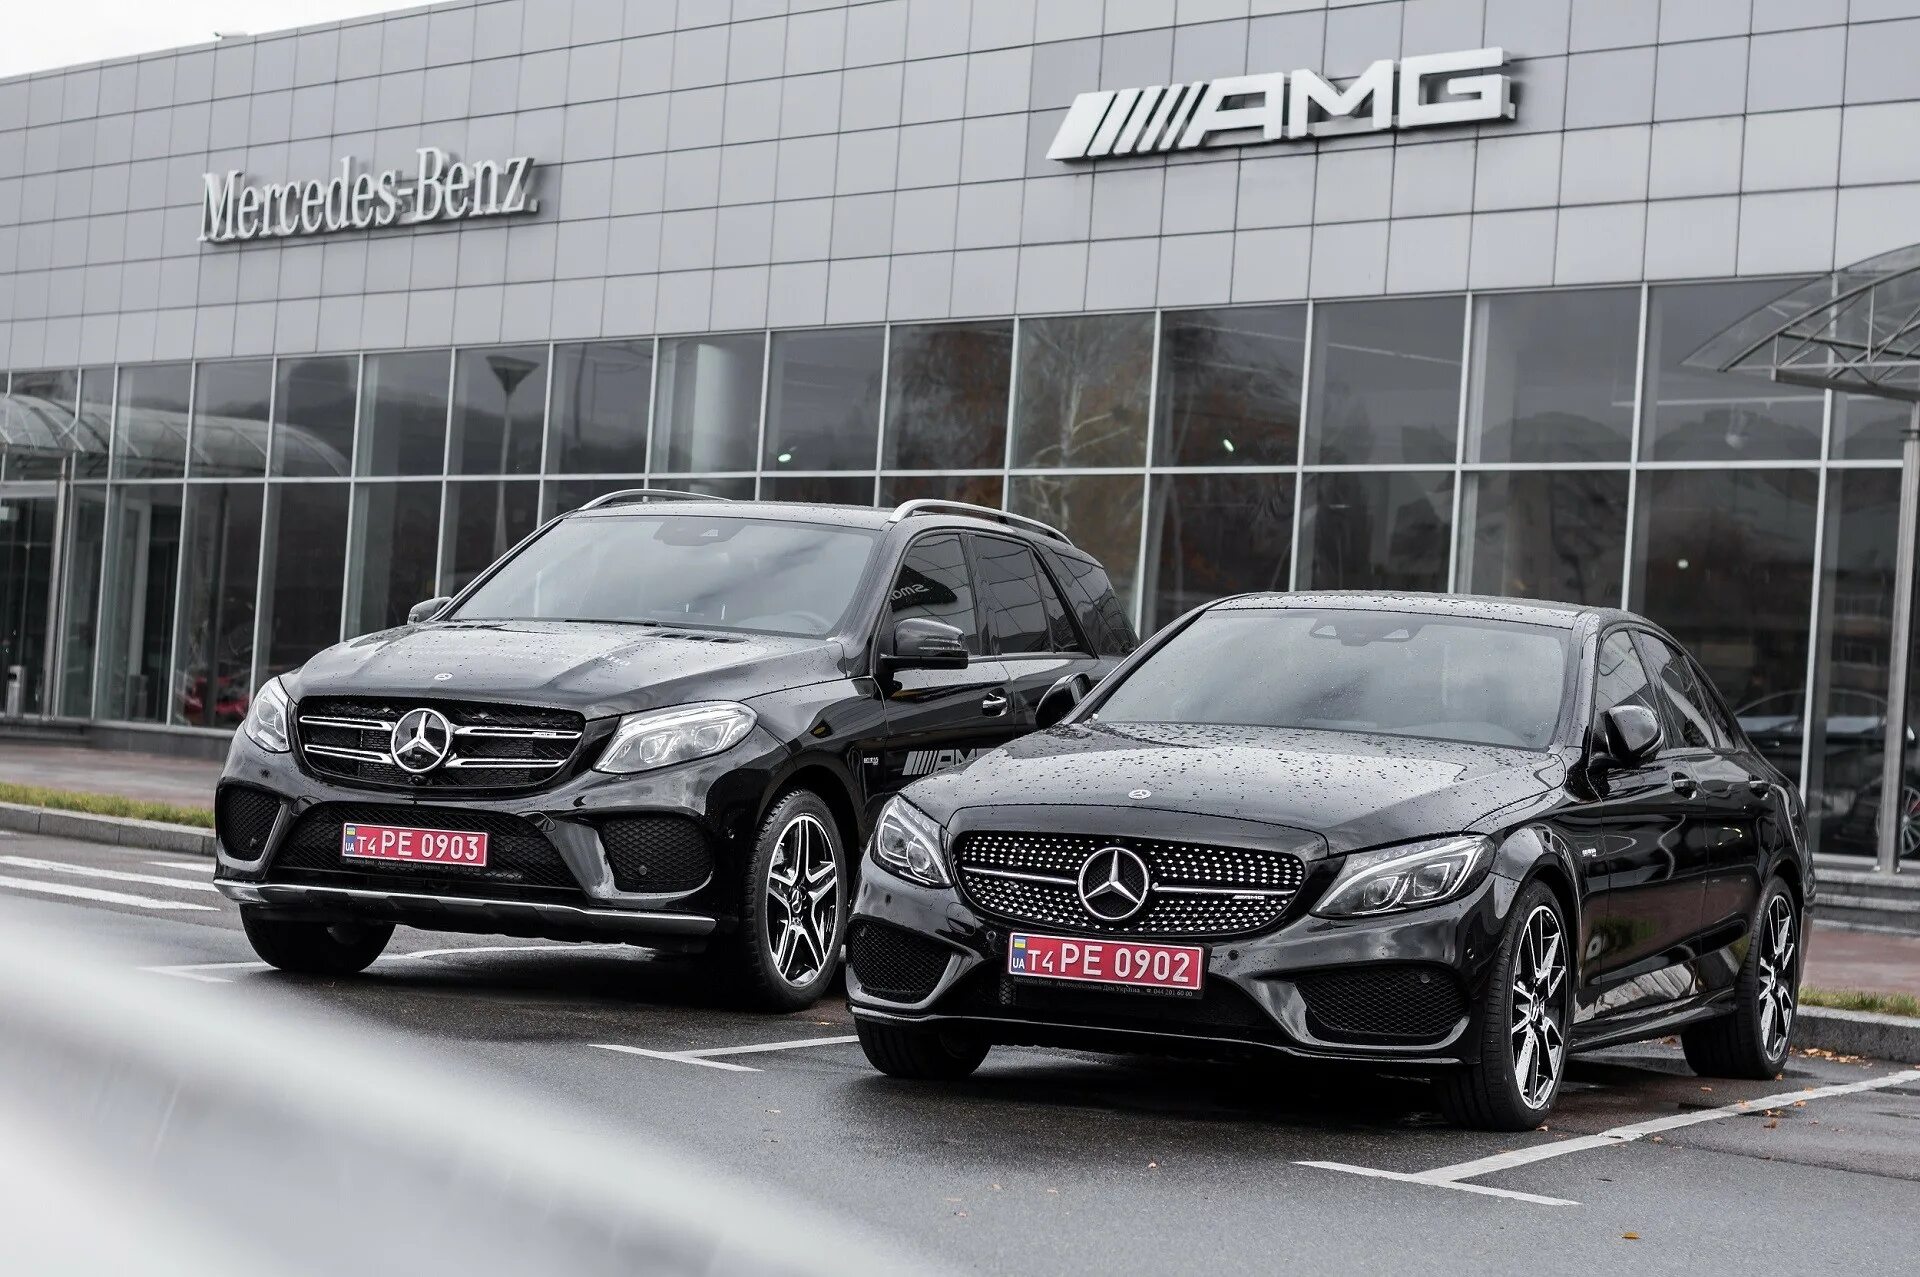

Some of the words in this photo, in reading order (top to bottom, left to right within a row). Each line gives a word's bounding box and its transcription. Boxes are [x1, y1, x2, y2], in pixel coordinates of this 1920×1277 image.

[1178, 47, 1514, 148] AMG
[197, 147, 538, 241] Mercedes-Benz
[345, 842, 355, 852] UA
[421, 833, 479, 861] 0903
[1012, 957, 1025, 969] UA
[1114, 948, 1190, 983] 0902
